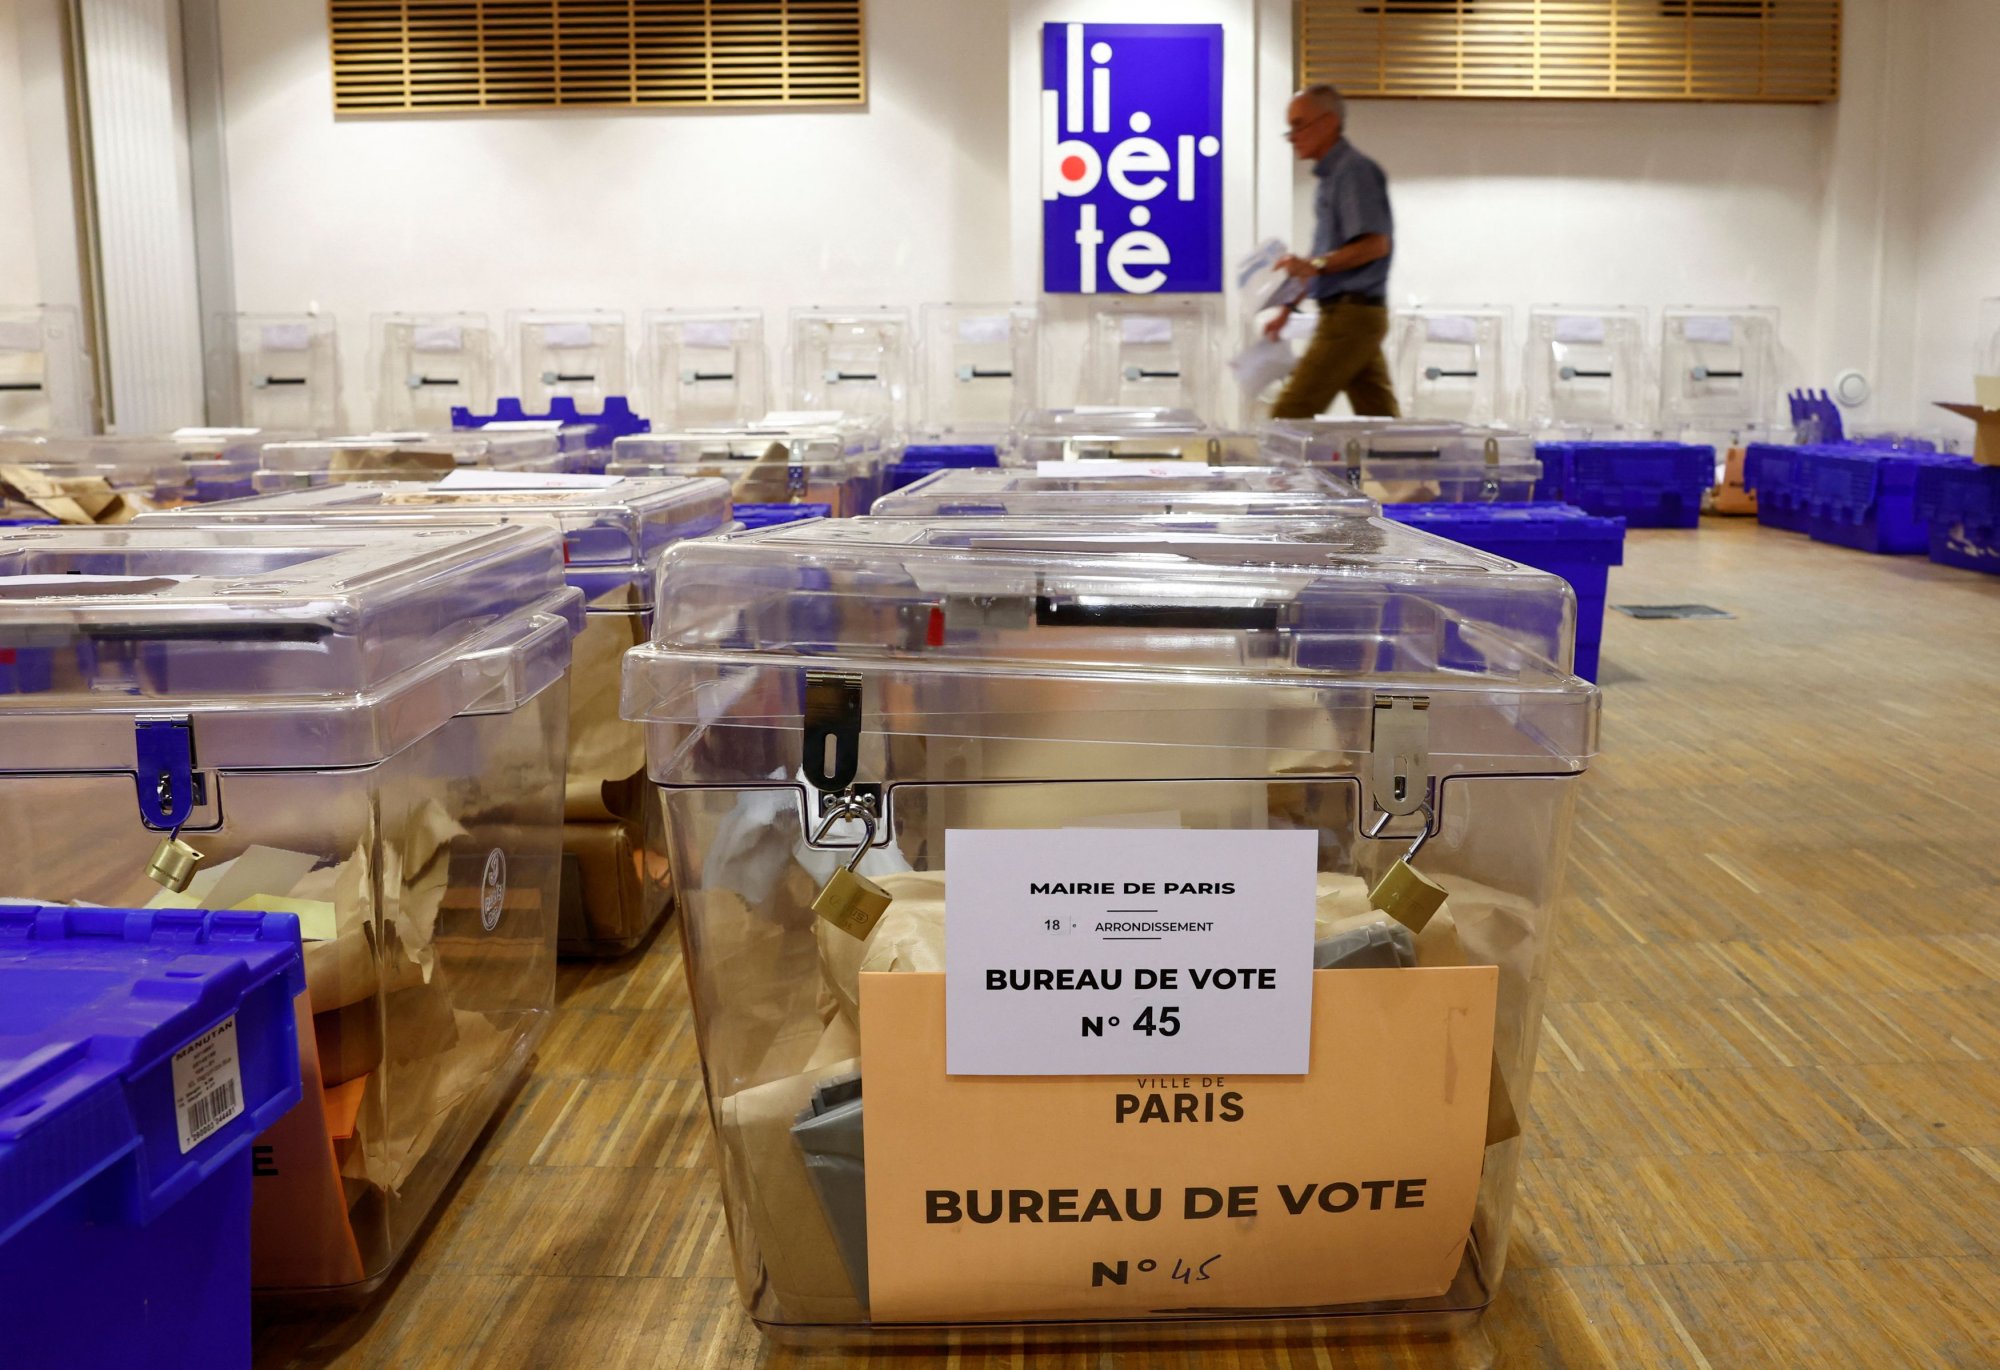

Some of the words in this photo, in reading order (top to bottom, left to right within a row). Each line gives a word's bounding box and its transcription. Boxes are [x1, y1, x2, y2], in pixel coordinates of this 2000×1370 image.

[1030, 882, 1115, 895] MAIRIE
[1123, 882, 1156, 895] DE
[1164, 882, 1236, 895] PARIS
[1044, 919, 1060, 931] 18
[1095, 922, 1214, 932] ARRONDISSEMENT
[985, 968, 1122, 991] BUREAU
[1134, 968, 1178, 990] DE
[1188, 968, 1277, 990] VOTE
[1132, 1005, 1181, 1037] 45
[175, 1021, 233, 1060] MANUTAN
[1137, 1078, 1190, 1089] VILLE
[1202, 1076, 1225, 1088] DE
[1115, 1091, 1245, 1124] PARIS
[925, 1187, 1162, 1224] BUREAU
[1183, 1185, 1259, 1219] DE
[1277, 1178, 1427, 1215] VOTE
[1171, 1253, 1222, 1283] 45
